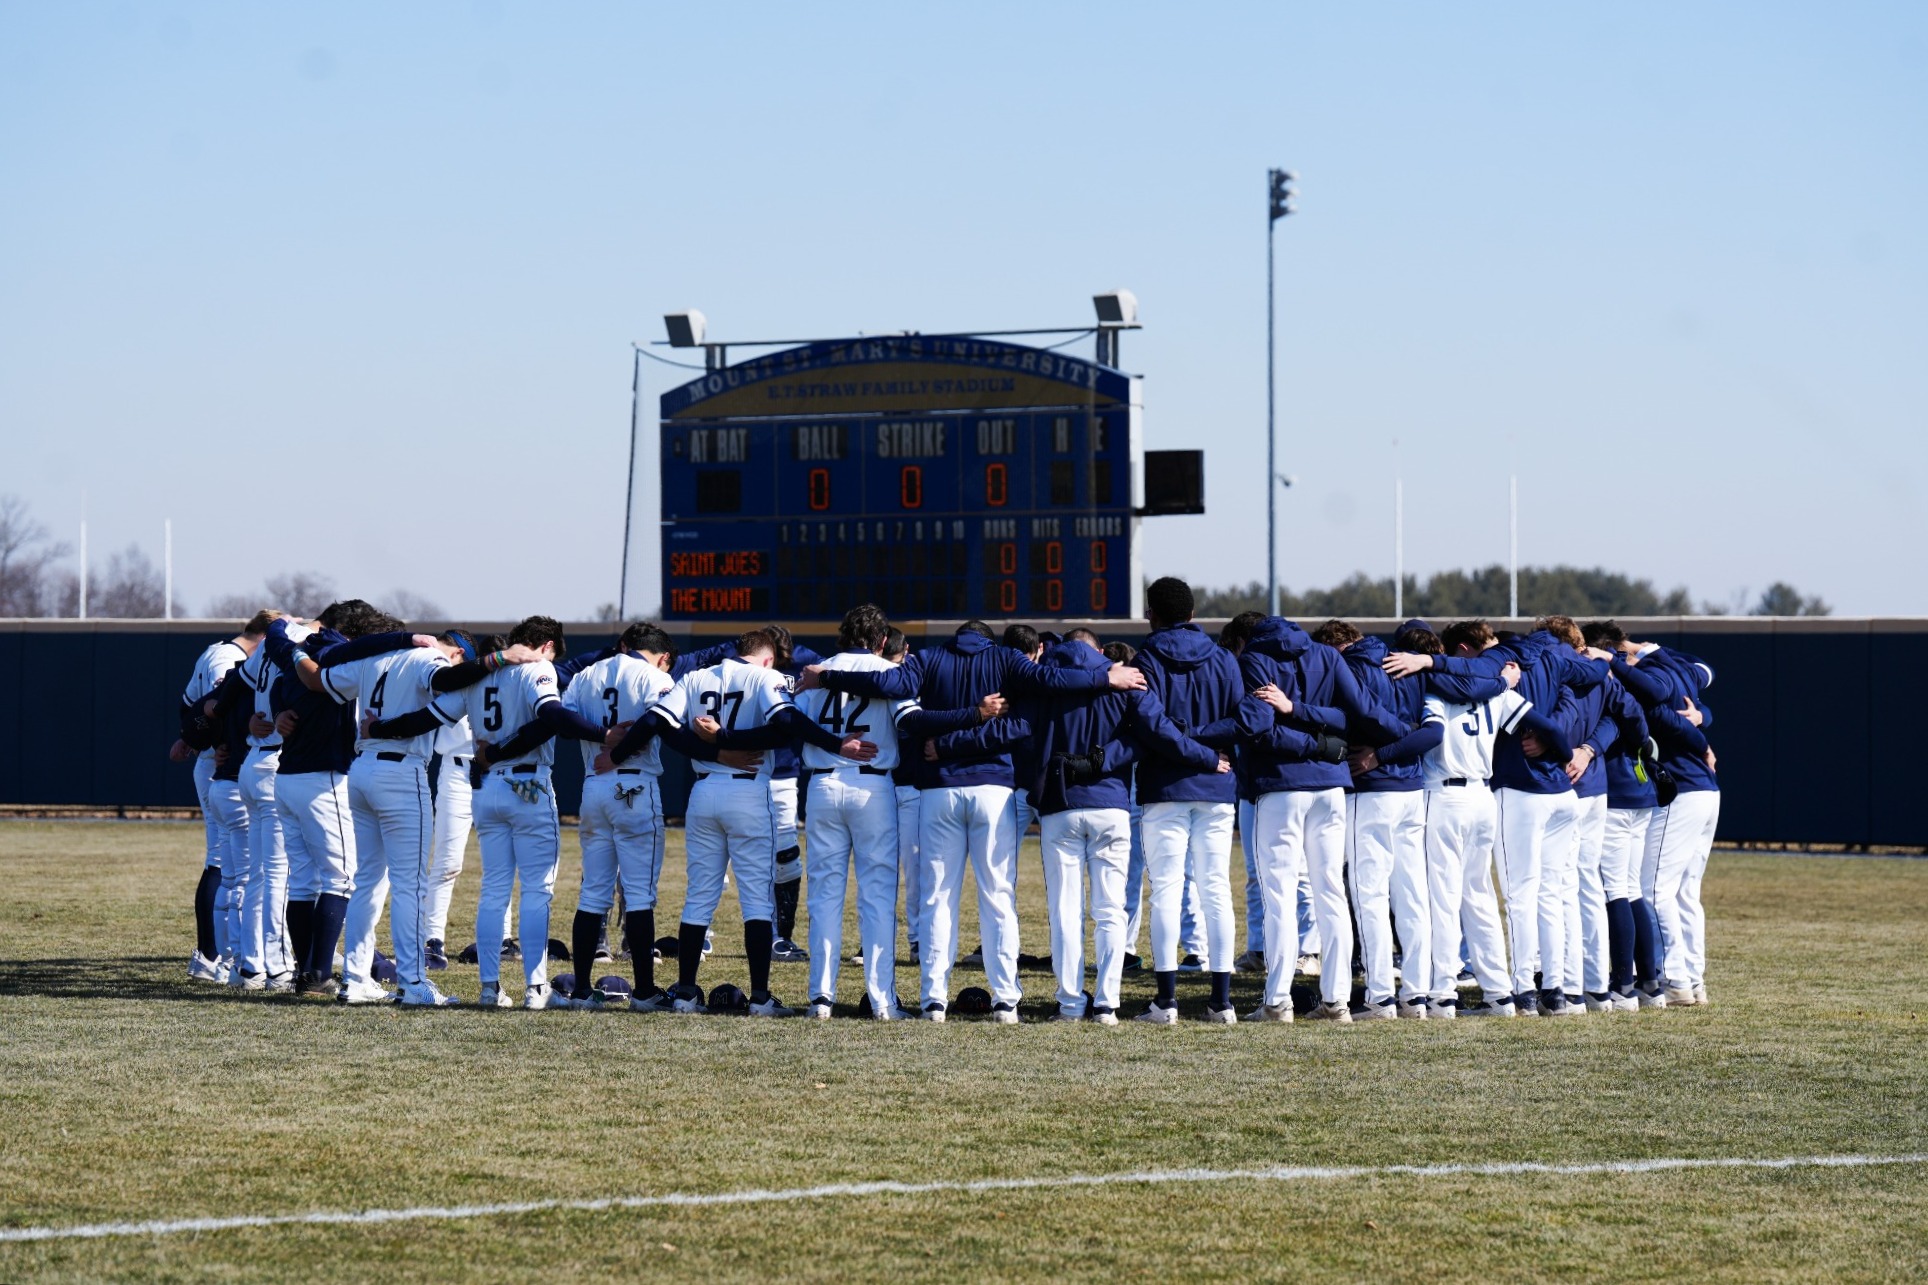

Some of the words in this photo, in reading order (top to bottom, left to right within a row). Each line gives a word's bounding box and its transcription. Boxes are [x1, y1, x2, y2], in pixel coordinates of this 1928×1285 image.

[688, 358, 774, 402] MOUNT
[782, 348, 821, 371] ST.
[830, 339, 923, 363] MARY'S
[933, 341, 1102, 387] UNIVERSITY
[862, 380, 929, 396] FAMILY
[932, 377, 1015, 394] STADIUM
[690, 429, 708, 463] AT
[716, 428, 747, 463] BAT
[797, 425, 840, 460] BALL
[877, 422, 945, 458] STRIKE
[977, 419, 1015, 455] OUT
[809, 468, 830, 511] 0
[901, 465, 922, 508] 0
[986, 463, 1007, 507] 0
[799, 523, 808, 543] 2
[818, 522, 827, 543] 3
[837, 522, 846, 542] 4
[856, 521, 866, 542] 5
[895, 521, 904, 541] 7
[952, 519, 966, 541] 10
[983, 518, 1016, 539] RUNS
[1031, 517, 1060, 538] HITS
[1074, 516, 1123, 537] ERRORS
[670, 551, 717, 577] SAINT
[719, 550, 761, 576] JOES
[1000, 543, 1017, 574] 0
[1046, 541, 1062, 574] 0
[1090, 540, 1107, 573] 0
[670, 587, 698, 612] THE
[701, 586, 752, 612] MOUNT
[1000, 580, 1017, 612] 0
[1046, 579, 1062, 611] 0
[1091, 578, 1107, 610] 0
[369, 671, 389, 718] 4
[483, 687, 503, 732] 5
[602, 687, 619, 728] 3
[699, 690, 745, 731] 37
[818, 688, 871, 734] 42
[1460, 701, 1494, 736] 31
